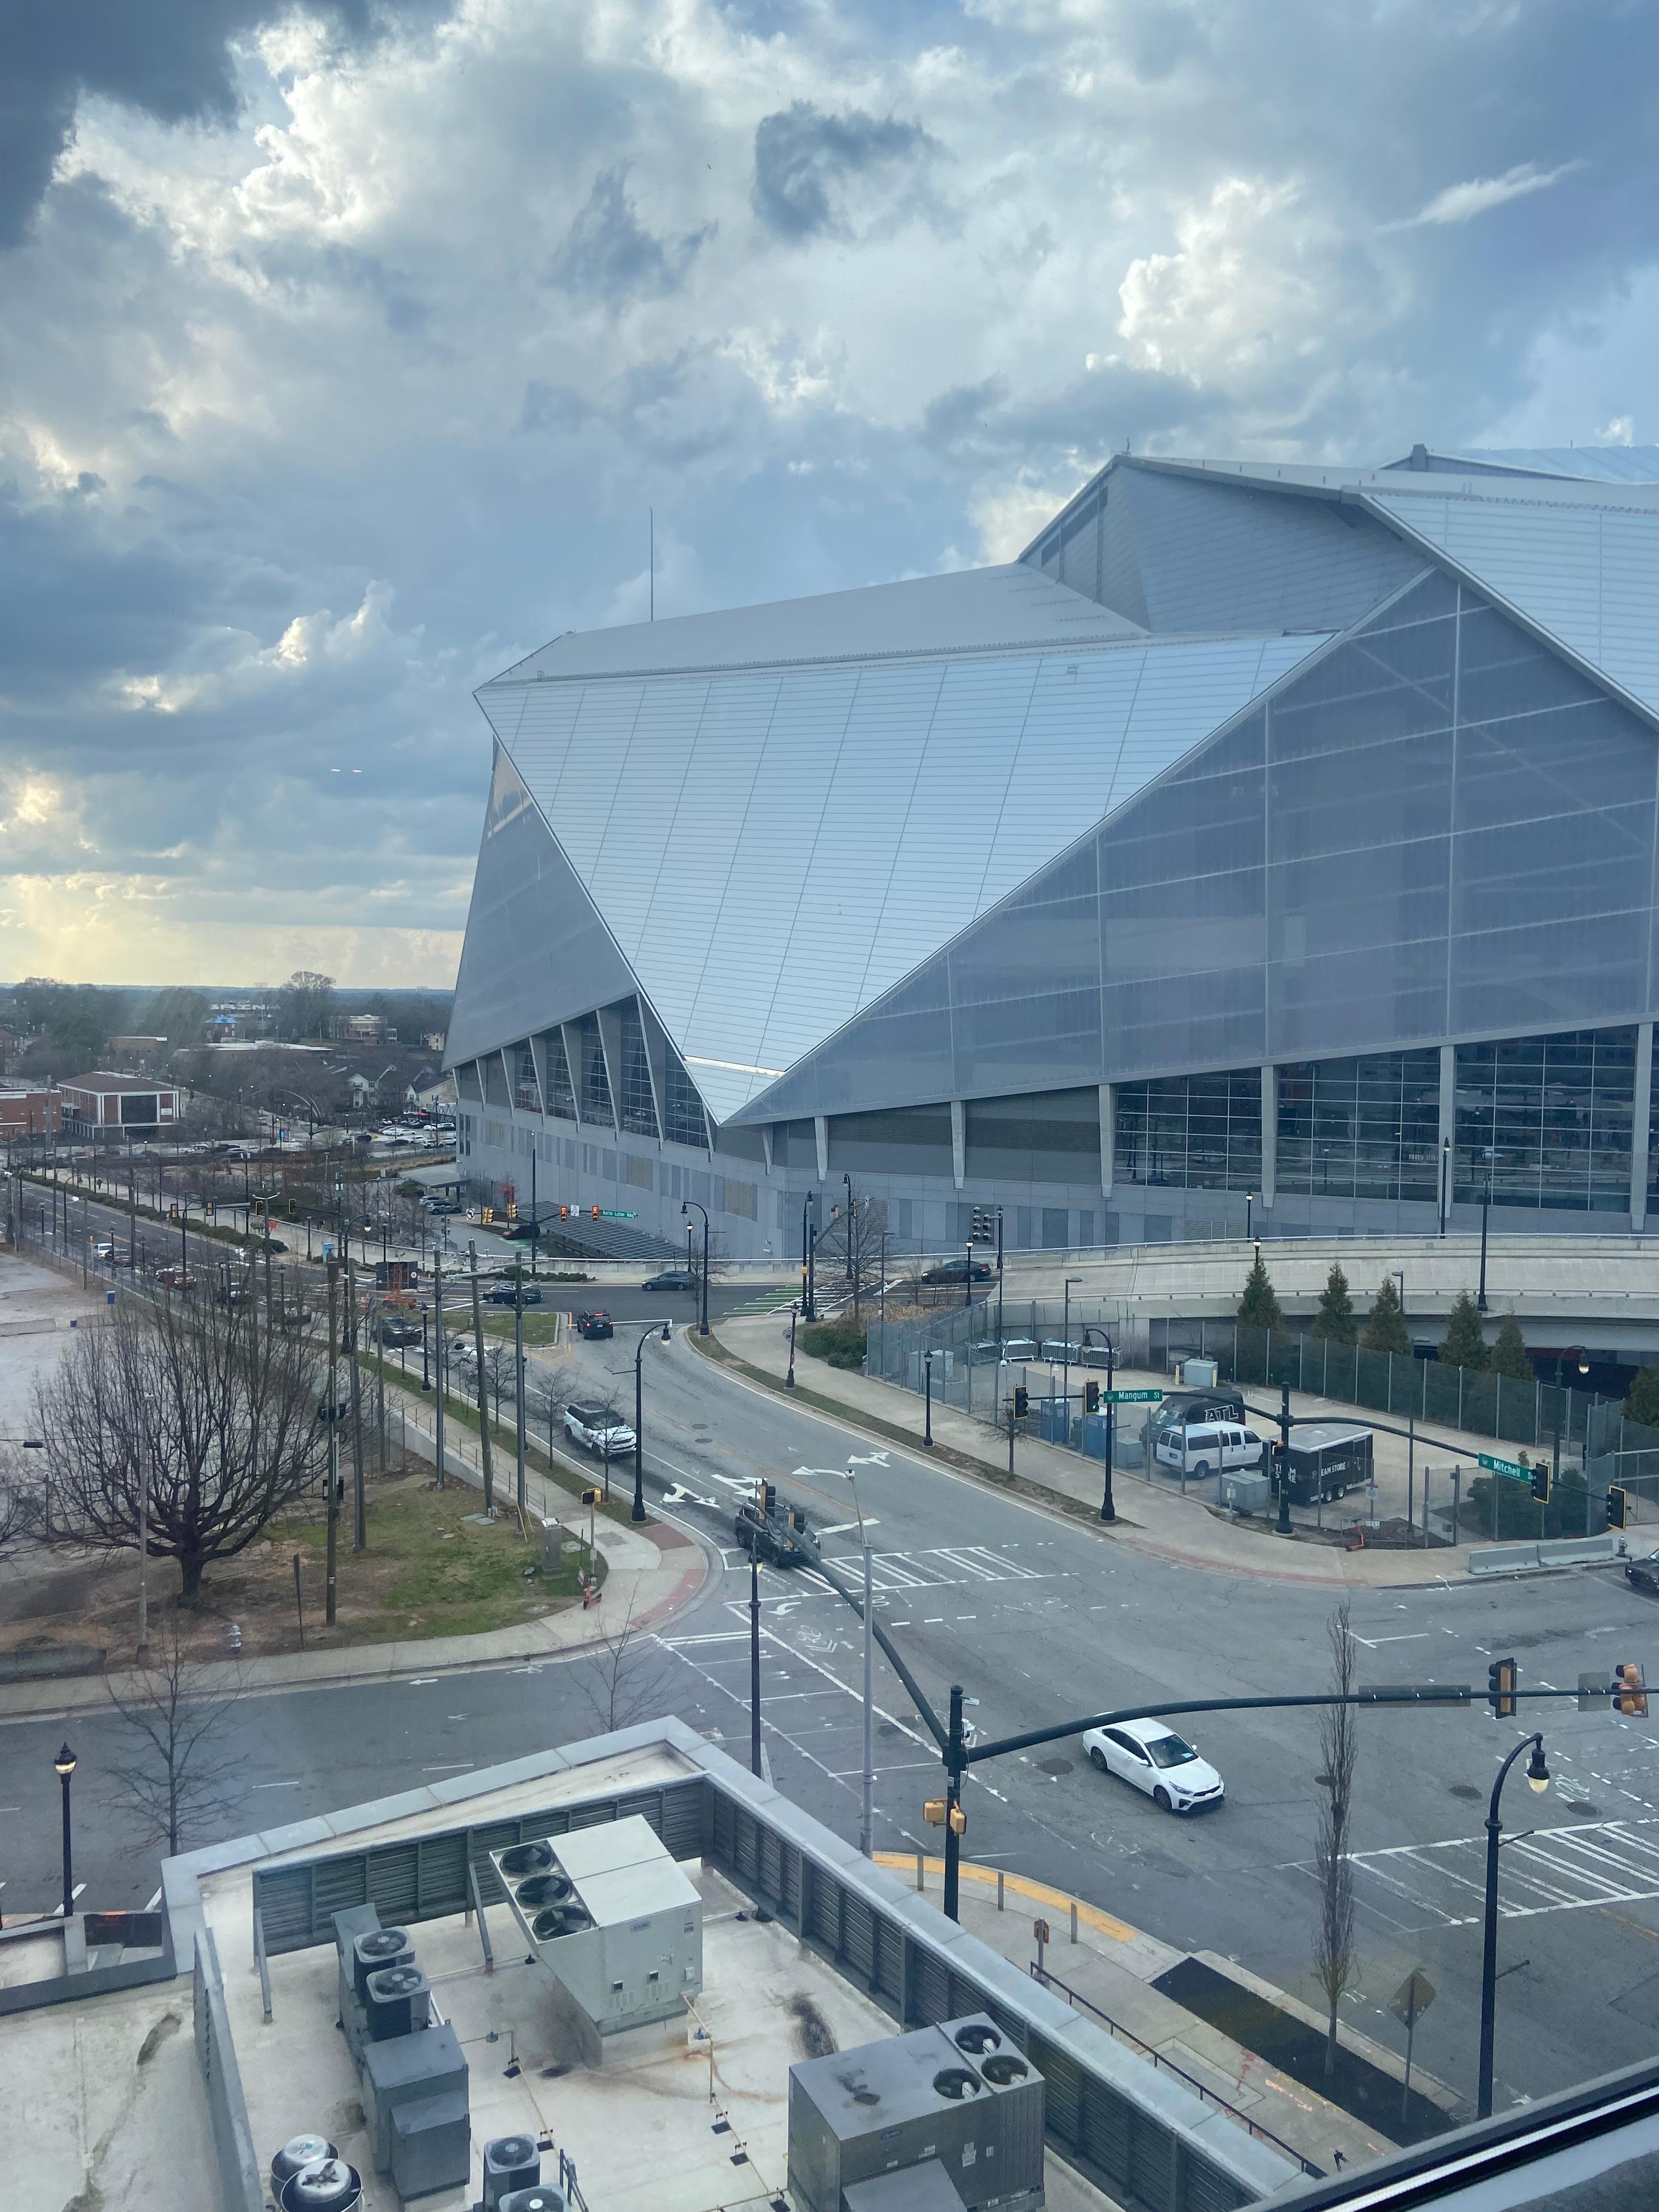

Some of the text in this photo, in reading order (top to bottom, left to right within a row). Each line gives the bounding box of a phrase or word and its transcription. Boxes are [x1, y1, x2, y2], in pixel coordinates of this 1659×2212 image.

[1119, 1391, 1148, 1401] Mangum
[1204, 1404, 1239, 1423] ATL
[1321, 1462, 1346, 1477] EAM STORE
[1493, 1459, 1521, 1477] Mitchell
